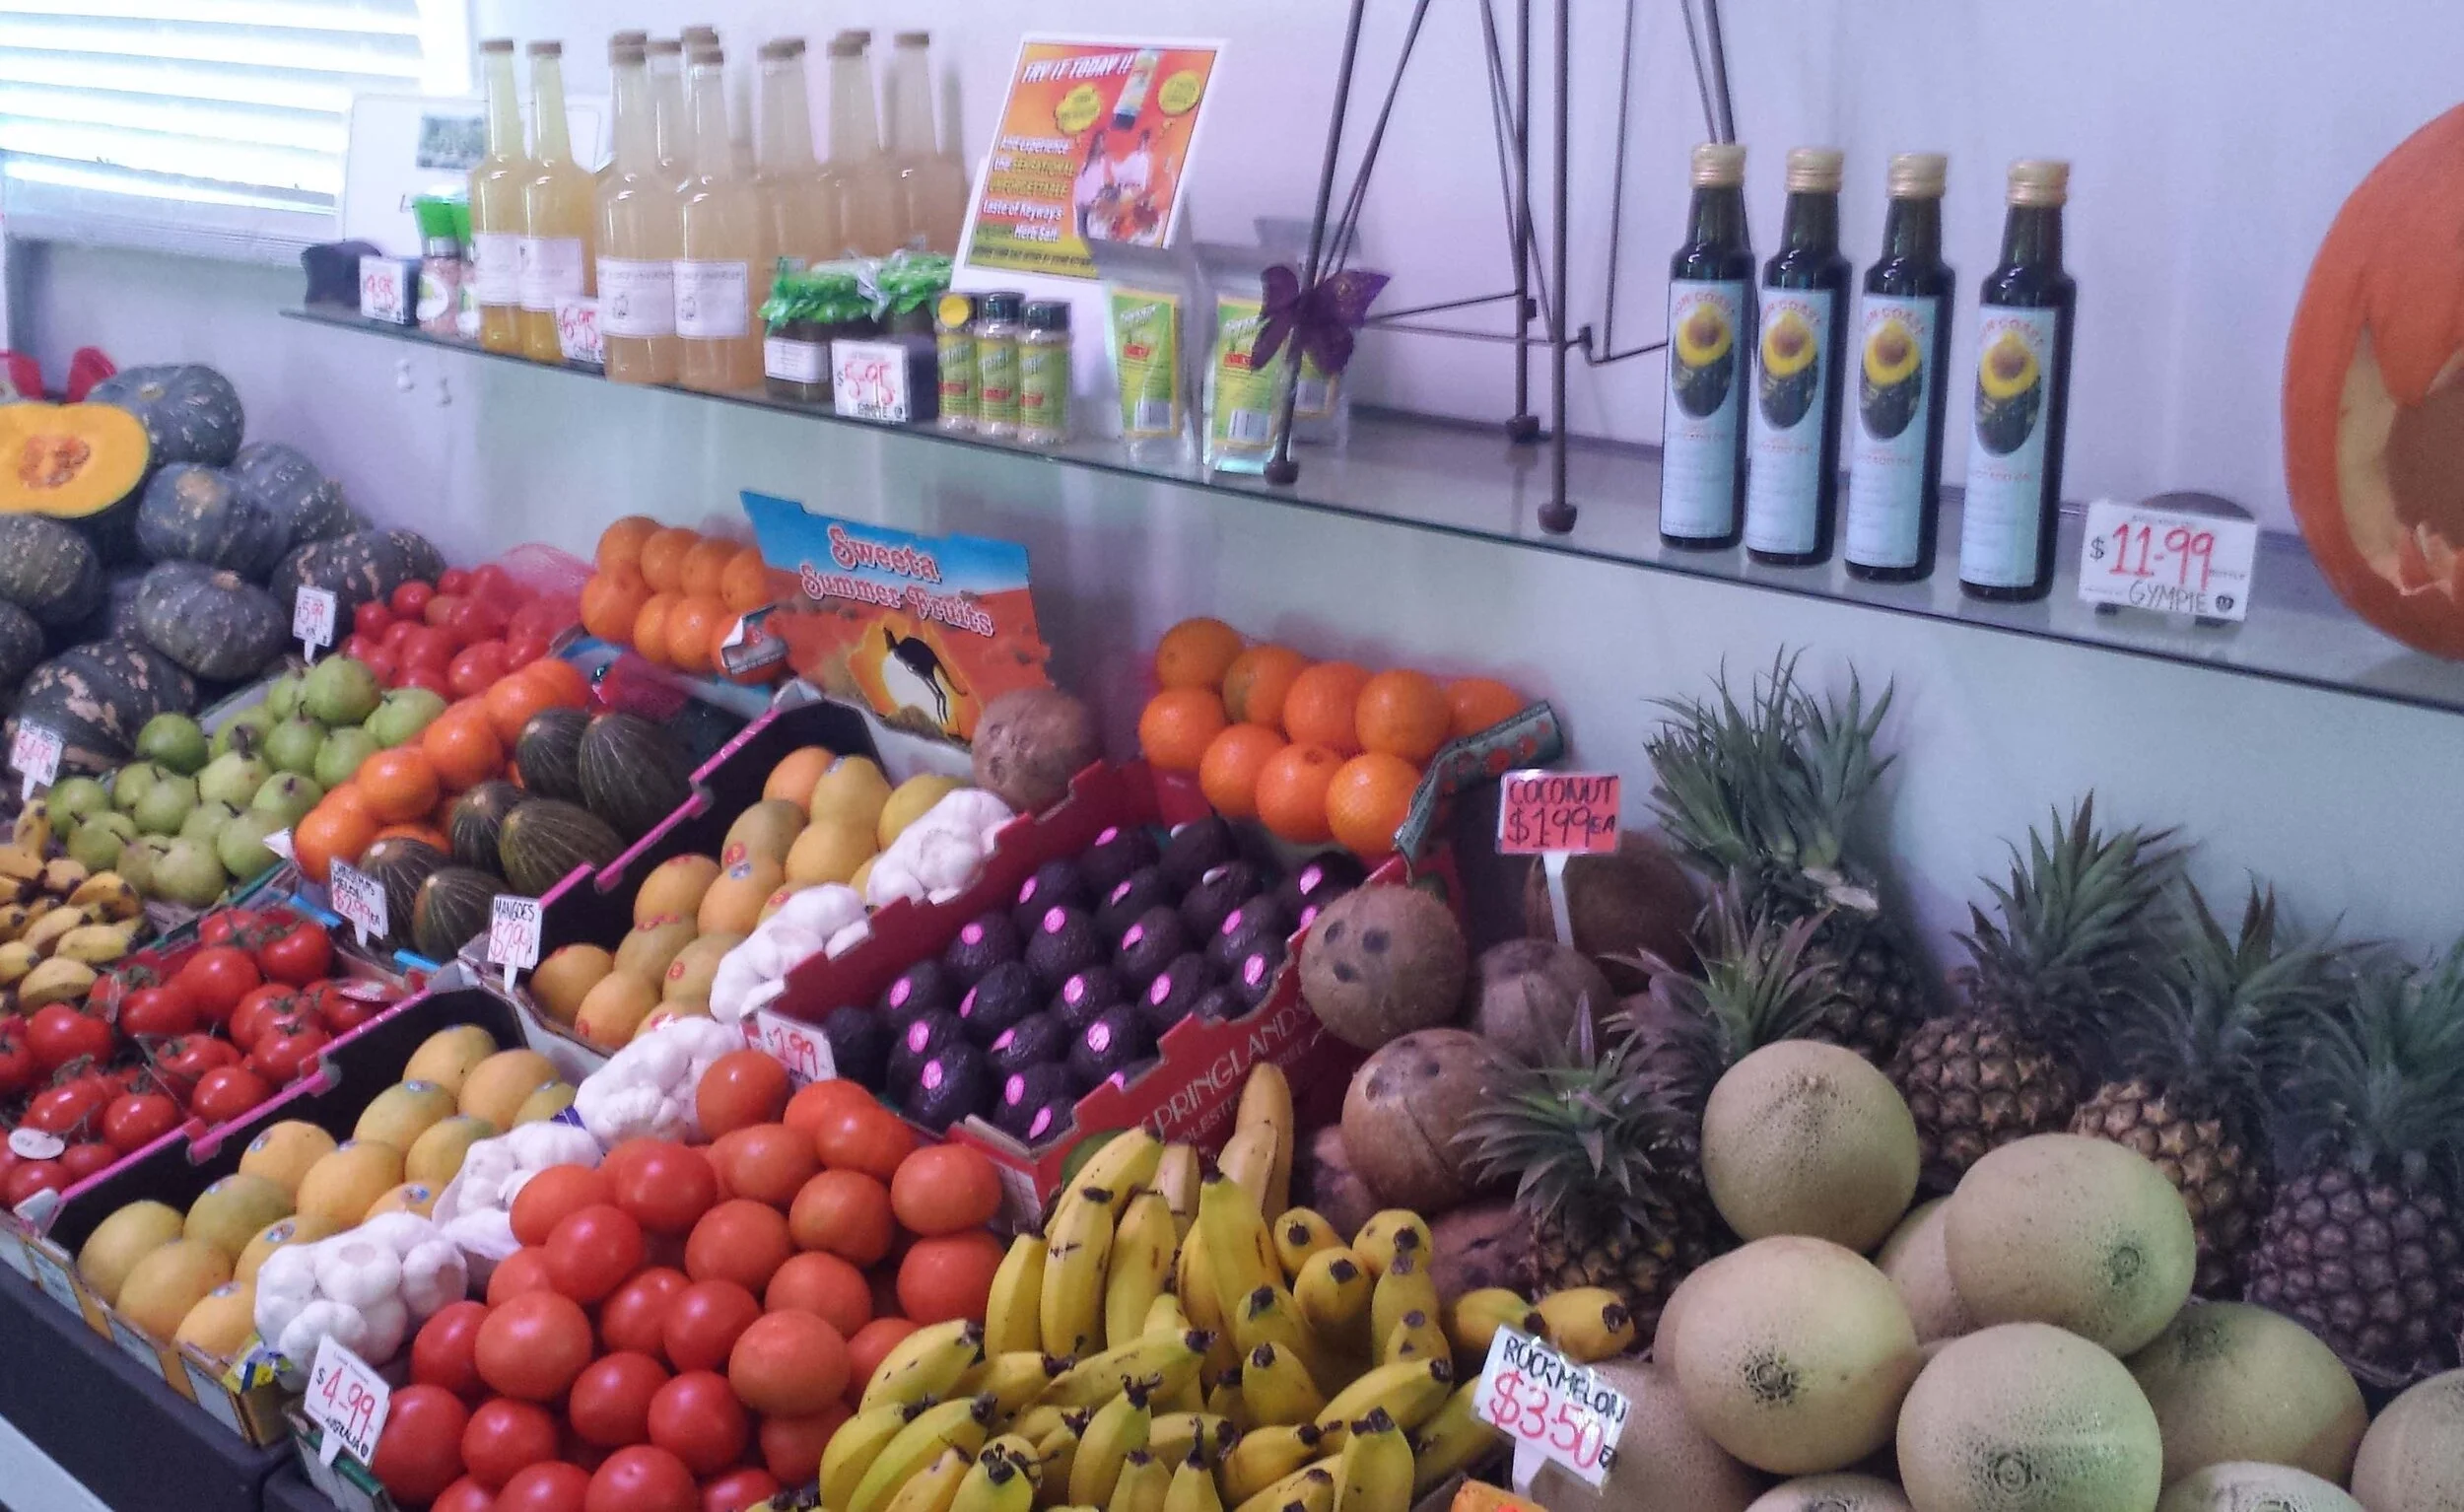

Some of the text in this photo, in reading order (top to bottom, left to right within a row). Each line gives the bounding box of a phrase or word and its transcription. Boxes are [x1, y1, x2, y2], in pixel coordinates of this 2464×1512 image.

[1021, 62, 1049, 83] TRY
[1050, 61, 1067, 81] IT
[1068, 55, 1119, 79] TODAY
[827, 523, 942, 584] Sweeta
[798, 562, 995, 638] Summer Fruits
[2128, 579, 2209, 613] GYMPIE
[1508, 775, 1619, 806] COCONUT
[1503, 1336, 1629, 1423] ROCKMELON
